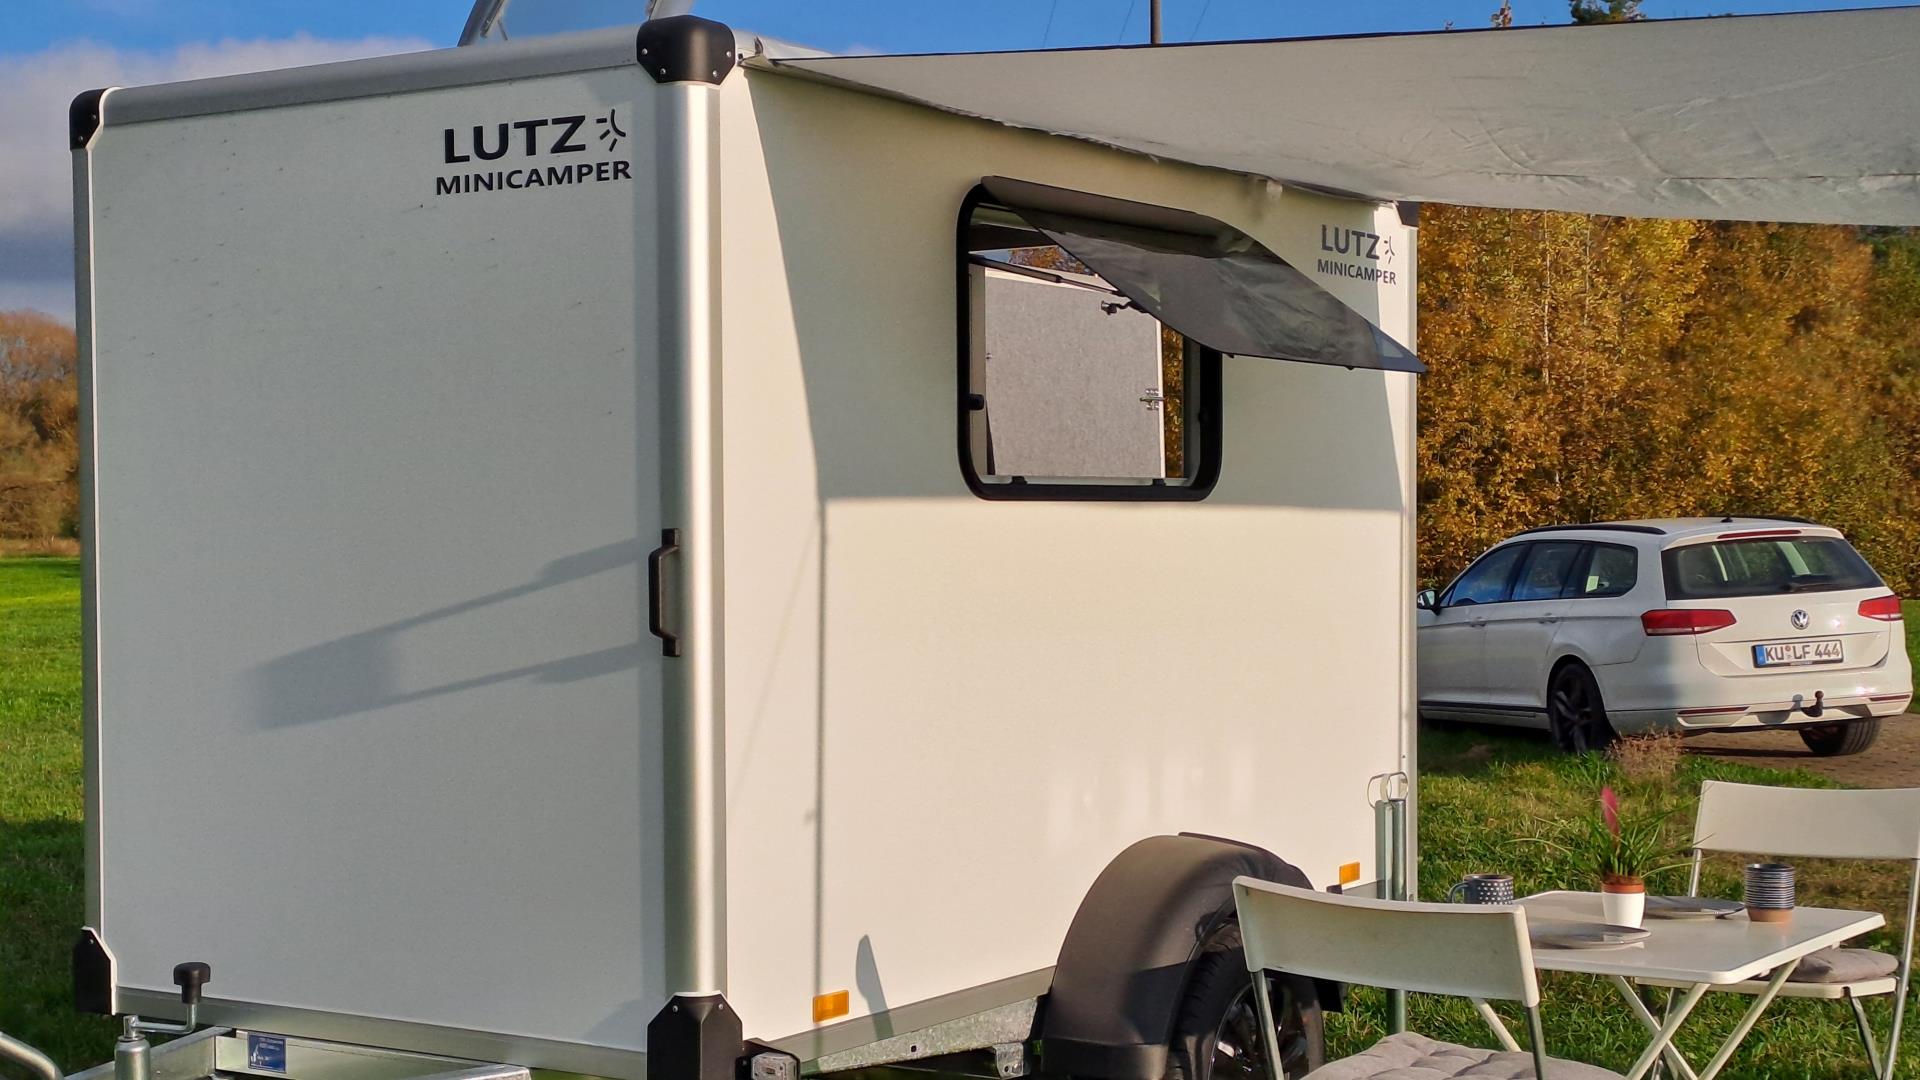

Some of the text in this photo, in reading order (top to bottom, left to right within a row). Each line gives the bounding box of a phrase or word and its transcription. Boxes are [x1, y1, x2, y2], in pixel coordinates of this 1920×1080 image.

[444, 115, 586, 164] LUTZ
[436, 160, 632, 195] MINICAMPER
[1321, 224, 1380, 260] LUTZ
[1317, 258, 1396, 285] MINICAMPER
[1815, 643, 1840, 657] 444
